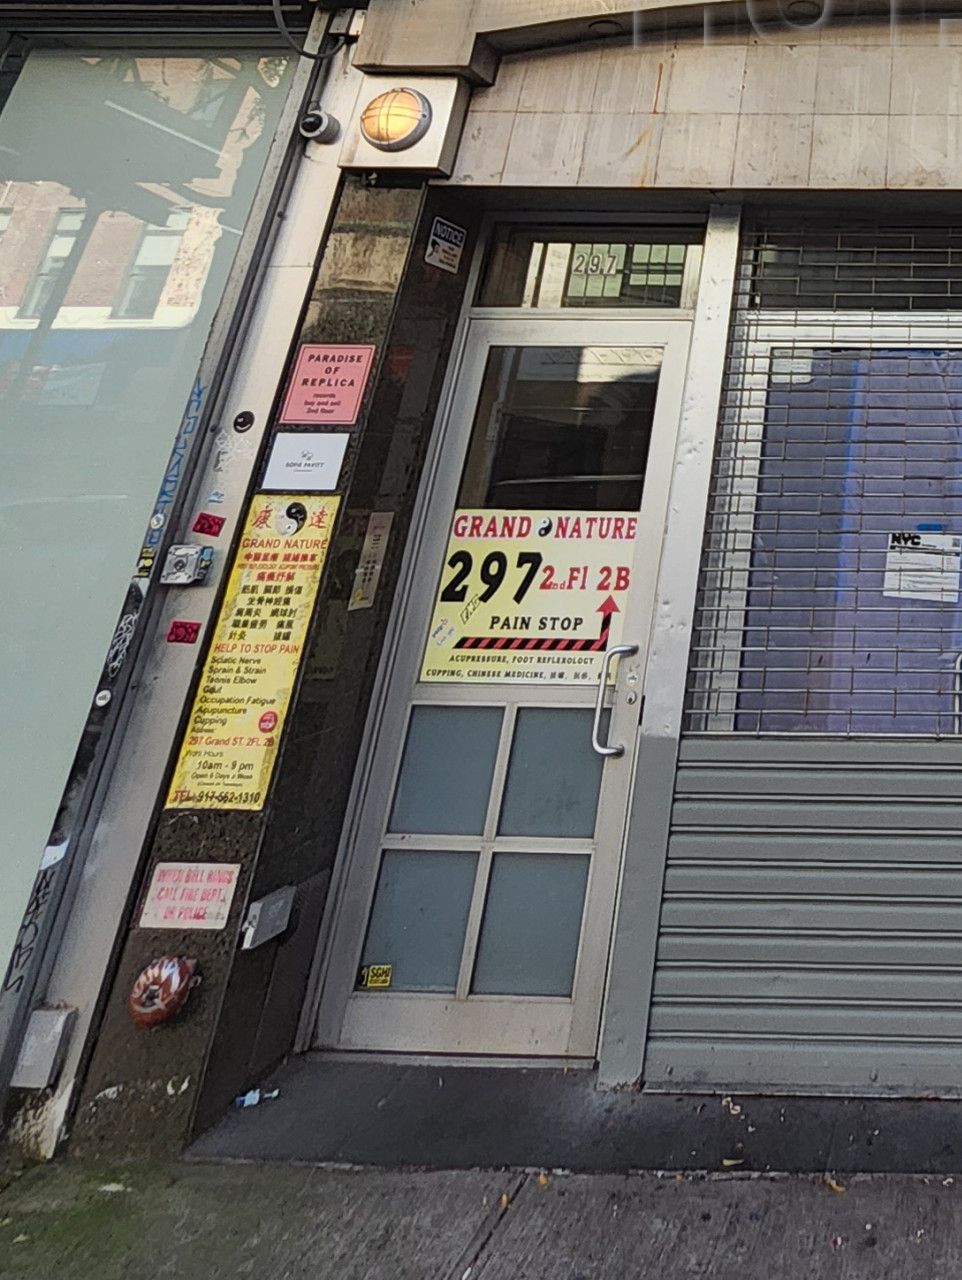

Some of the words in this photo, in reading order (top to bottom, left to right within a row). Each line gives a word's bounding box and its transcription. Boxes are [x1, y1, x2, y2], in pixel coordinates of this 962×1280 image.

[573, 254, 619, 275] 297
[308, 354, 363, 363] PARADISE
[324, 366, 340, 374] OF
[301, 378, 355, 387] REPLICA
[453, 515, 533, 539] GRAND
[554, 516, 638, 539] NATURE
[241, 538, 281, 549] GRAND
[284, 539, 328, 549] NATURE
[891, 533, 921, 546] NYC
[440, 550, 543, 604] 297
[597, 566, 630, 591] 2B
[489, 616, 537, 630] PAIN
[538, 617, 584, 631] STOP
[214, 643, 237, 653] HELP
[241, 643, 251, 653] TO
[254, 644, 277, 653] STOP
[279, 644, 299, 654] PAIN
[211, 656, 236, 664] Sciatic
[208, 666, 233, 675] Sprain
[236, 666, 241, 674] &
[244, 666, 266, 674] Strain
[426, 669, 463, 677] CUPPING,
[467, 670, 501, 678] CHINESE
[504, 671, 547, 679] MEDICINE,
[206, 676, 231, 684] Tennis
[233, 676, 257, 684] Elbow
[203, 685, 222, 694] Gout
[200, 696, 245, 705] Occupation
[246, 696, 276, 706] Fatigue
[194, 716, 227, 726] Cupping
[189, 736, 203, 746] 297
[205, 737, 230, 746] Grand
[197, 760, 222, 770] 10am
[231, 761, 237, 770] 9
[238, 763, 254, 773] pm
[191, 772, 208, 780] Open
[215, 773, 230, 781] Days
[184, 869, 203, 883] BELL
